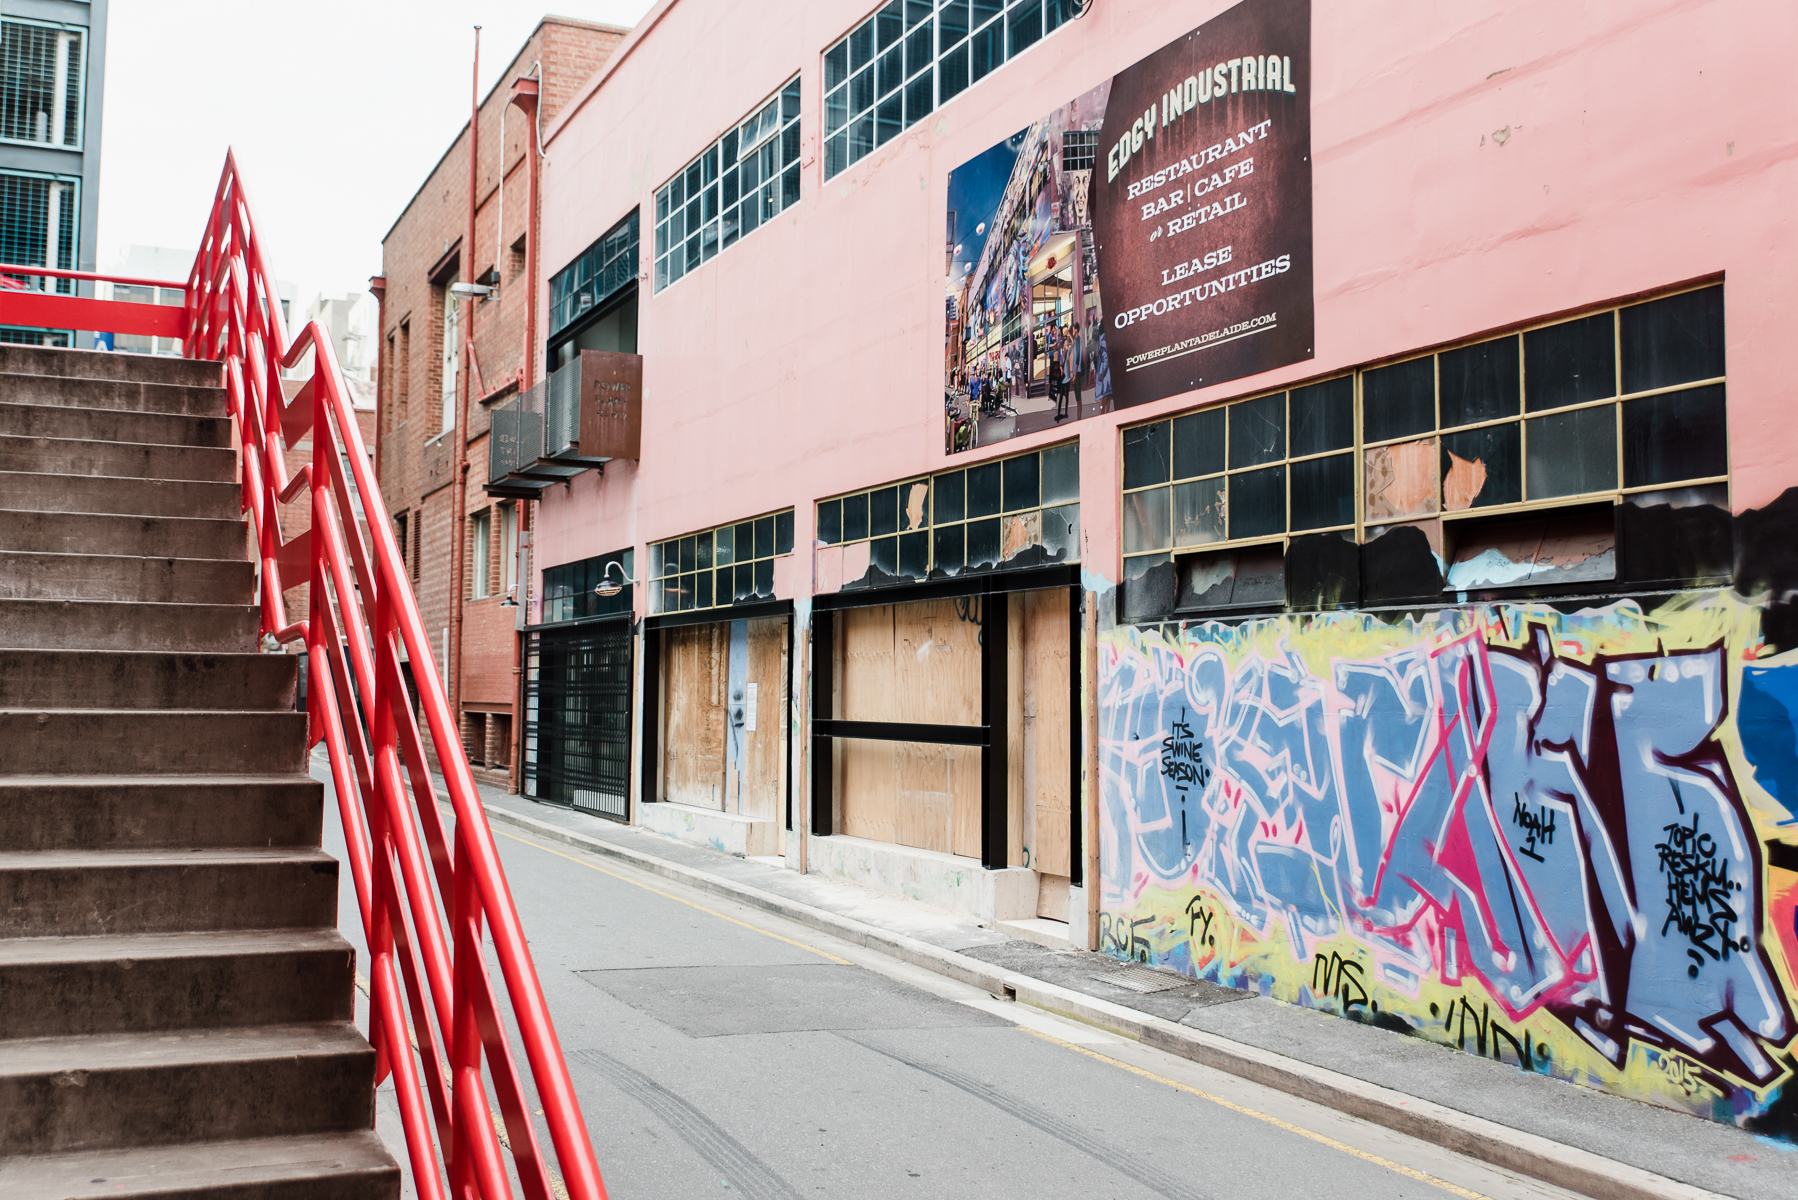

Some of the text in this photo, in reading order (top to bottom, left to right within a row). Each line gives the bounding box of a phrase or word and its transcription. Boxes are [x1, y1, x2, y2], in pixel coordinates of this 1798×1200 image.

[1107, 55, 1296, 184] EDGY INDUSTRIAL
[1127, 119, 1271, 200] RESTAURANT
[1141, 157, 1254, 221] BAR CAFE
[1167, 192, 1247, 237] RETAIL
[1161, 245, 1232, 286] LEASE
[1114, 253, 1291, 330] OPPORTUNITIES
[1125, 312, 1277, 367] POWERPLANTADELAIDE.COM
[594, 380, 631, 392] POWER
[595, 395, 628, 406] PLANT
[1161, 736, 1203, 763] SWINE
[1513, 791, 1556, 844] NOAH
[1663, 812, 1717, 858] TOPIC
[1658, 1054, 1702, 1092] 2015
